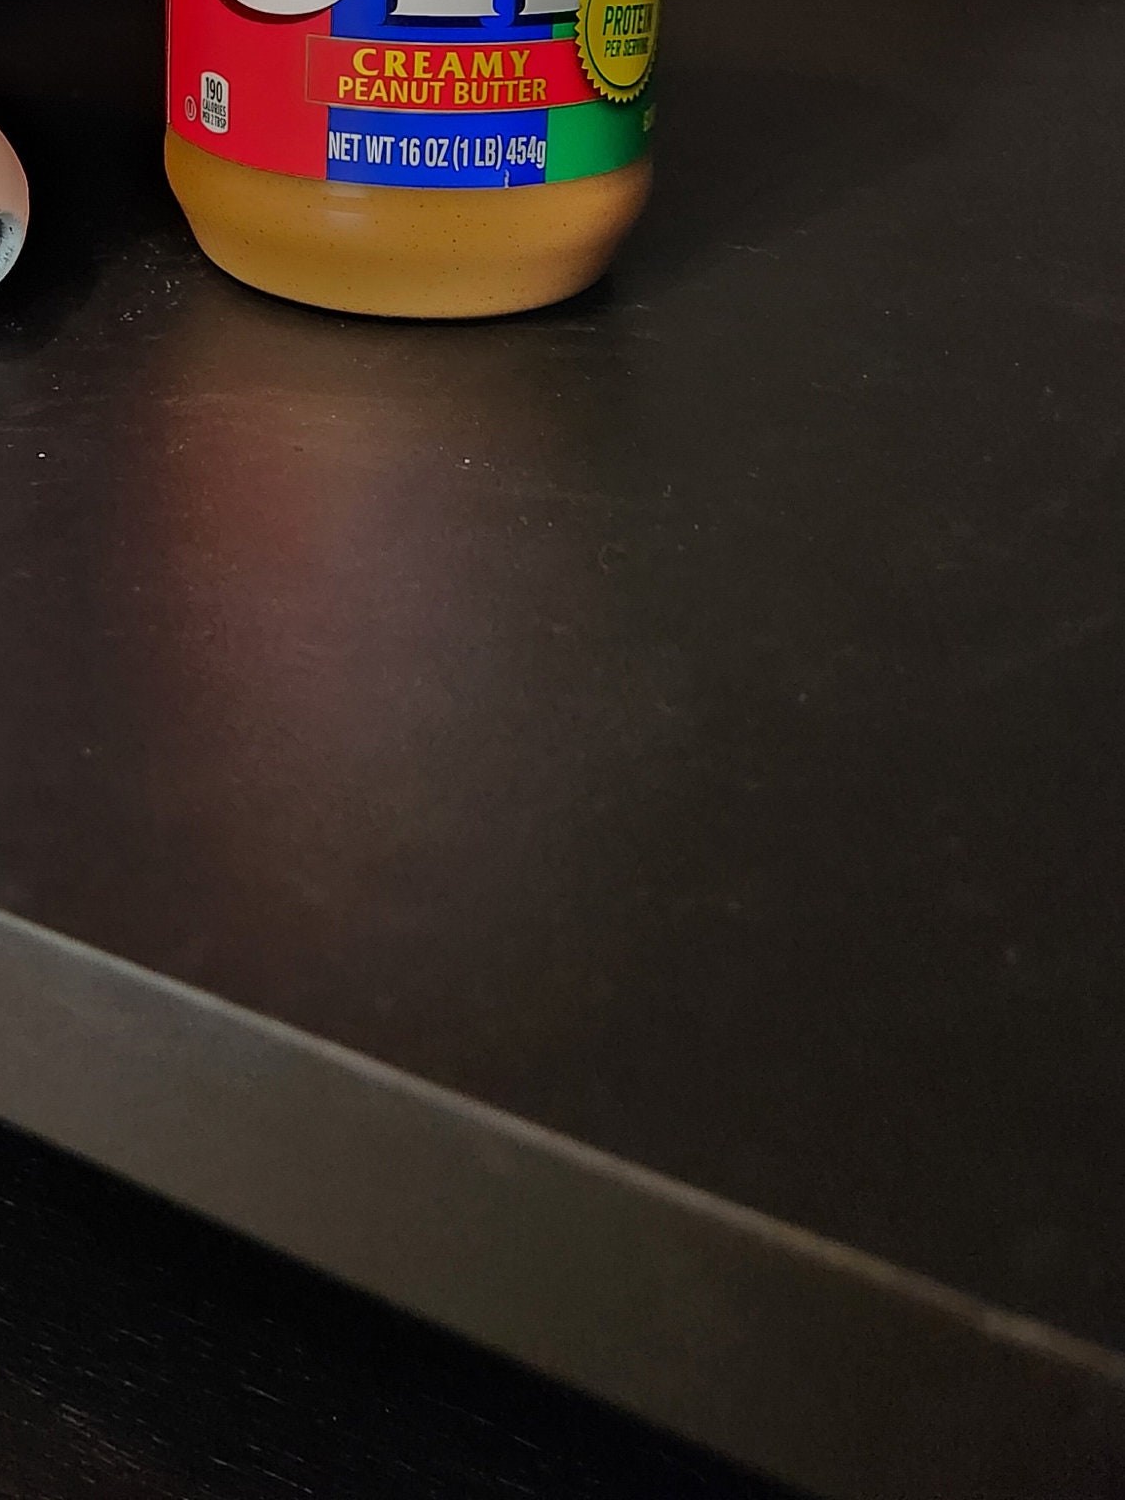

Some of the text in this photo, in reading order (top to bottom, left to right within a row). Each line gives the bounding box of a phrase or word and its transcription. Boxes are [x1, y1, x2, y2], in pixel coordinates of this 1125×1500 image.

[602, 3, 654, 36] PROTEIN
[352, 47, 531, 79] CREAMY
[604, 40, 621, 58] PER
[206, 77, 223, 103] 190
[338, 75, 547, 104] PEANUT BUTTER
[328, 130, 547, 172] NET WT 16 OZ (1 LB) 454g
